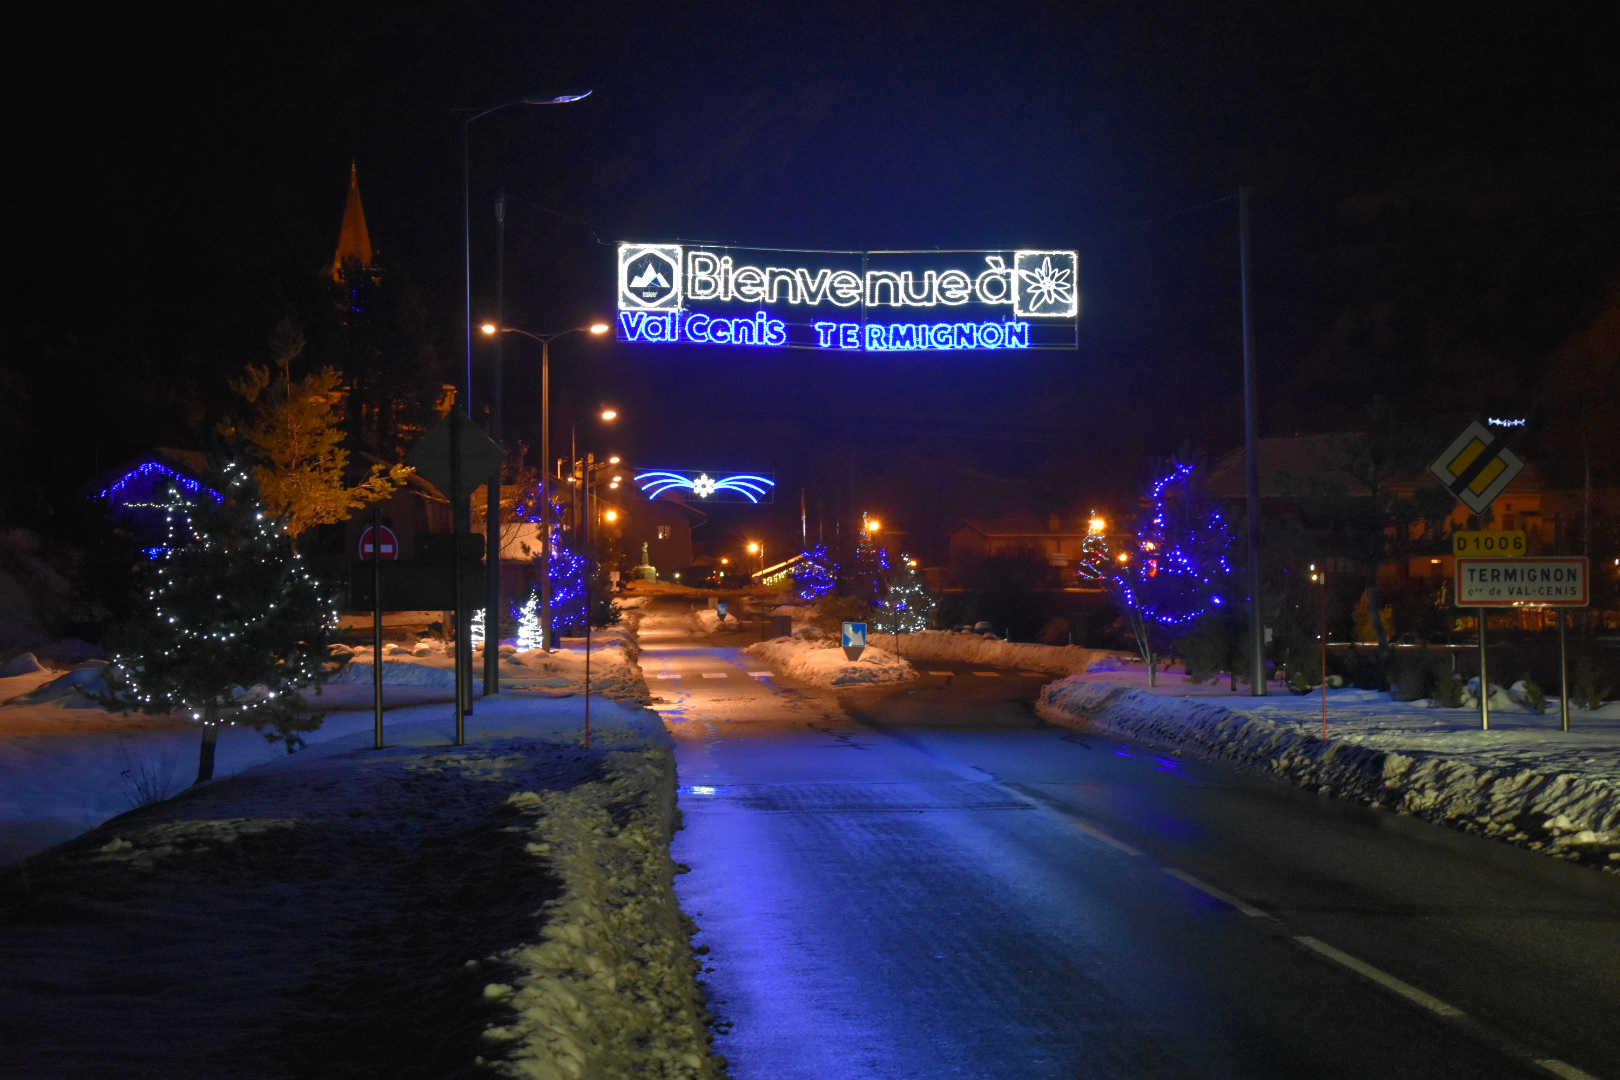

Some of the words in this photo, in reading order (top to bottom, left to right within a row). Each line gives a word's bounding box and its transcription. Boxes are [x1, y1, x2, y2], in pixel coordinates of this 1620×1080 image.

[687, 251, 972, 307] Bienvenue
[619, 310, 679, 342] Val
[685, 310, 787, 346] Cenis
[814, 321, 1030, 350] TERMIGNON
[1467, 568, 1577, 583] TERMIGNON
[1488, 586, 1502, 596] de
[1508, 586, 1577, 596] VAL-CENIS
